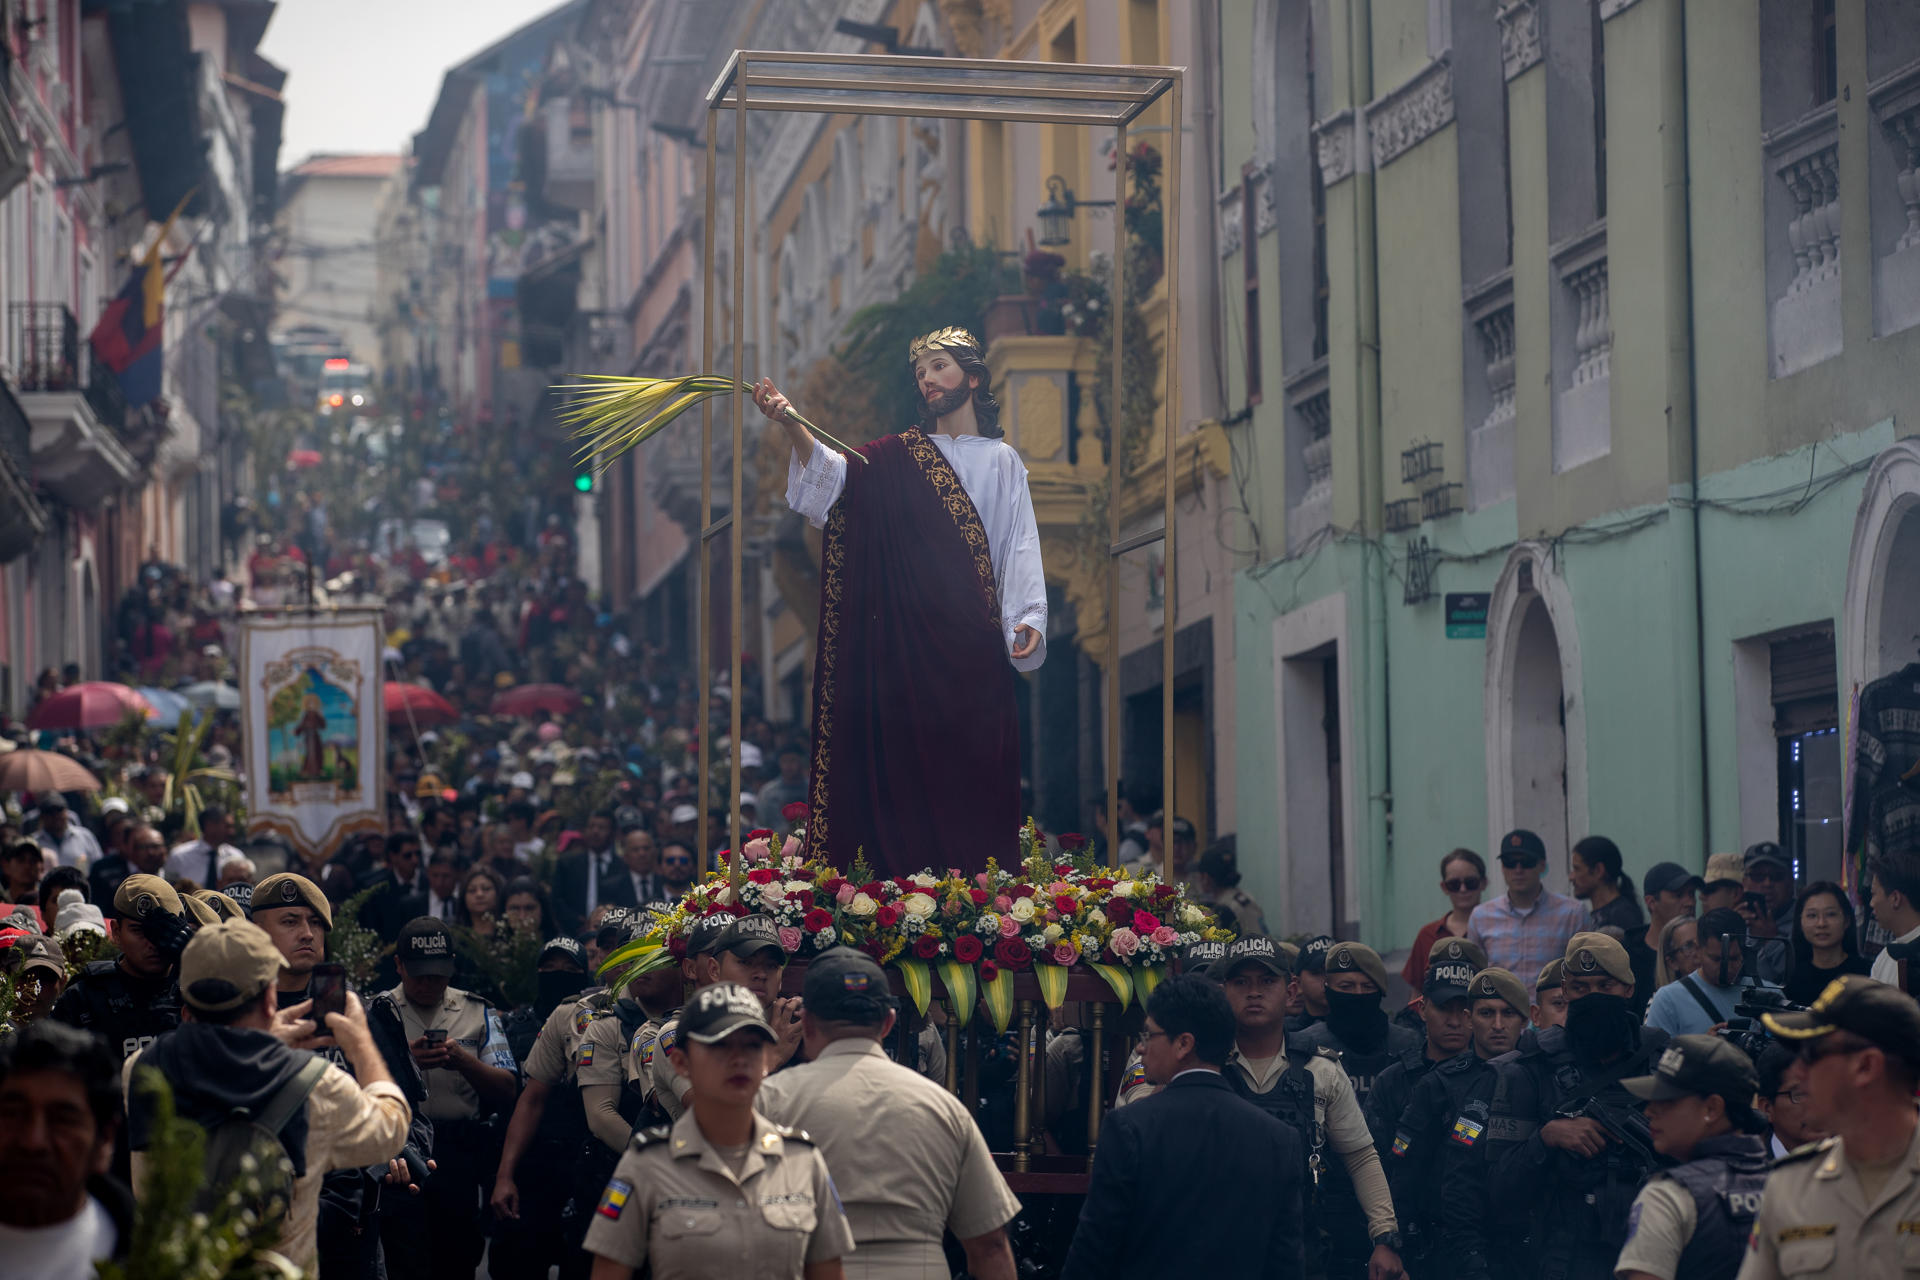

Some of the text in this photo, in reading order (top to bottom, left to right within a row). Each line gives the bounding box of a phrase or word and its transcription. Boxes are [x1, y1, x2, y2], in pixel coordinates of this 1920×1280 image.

[411, 931, 447, 950] POLICÍA
[1230, 937, 1275, 958] POLICÍA
[1244, 950, 1276, 958] NACIONAL
